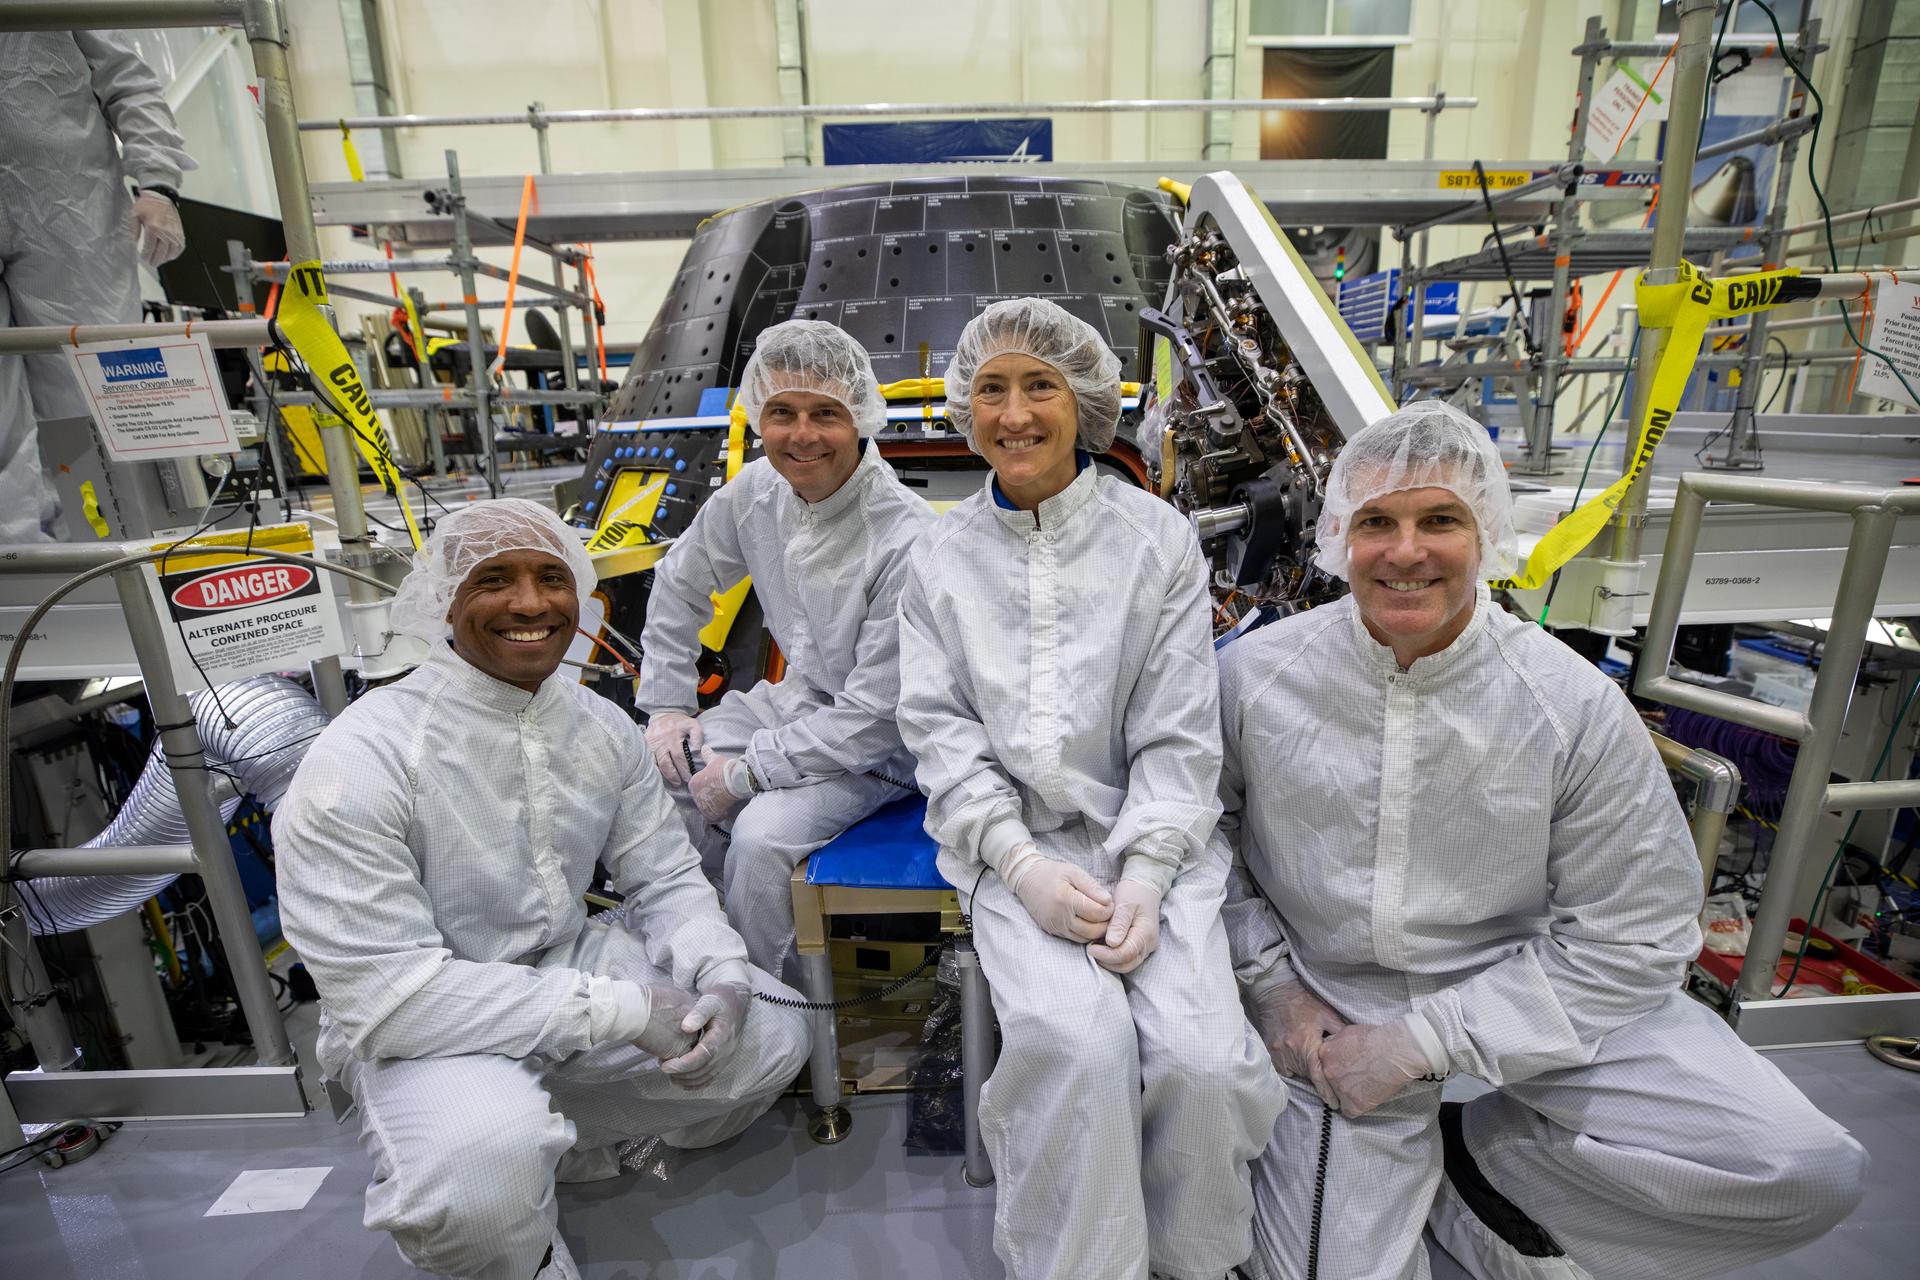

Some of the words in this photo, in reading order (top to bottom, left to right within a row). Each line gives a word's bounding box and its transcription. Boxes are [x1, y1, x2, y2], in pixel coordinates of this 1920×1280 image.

[1474, 175, 1494, 186] 80
[1500, 175, 1525, 186] SWL
[1727, 276, 1782, 311] CAU
[1885, 318, 1900, 327] Prior
[1884, 326, 1910, 338] Personnel
[1885, 336, 1905, 346] Forced
[101, 361, 166, 377] WARNING
[102, 383, 138, 393] Servomex
[140, 380, 170, 391] Oxygen
[172, 377, 196, 387] Meter
[200, 568, 294, 606] DANGER
[188, 617, 254, 641] ALTERNATE
[256, 604, 318, 627] PROCEDURE
[210, 628, 269, 648] CONFINED
[271, 619, 304, 635] SPACE
